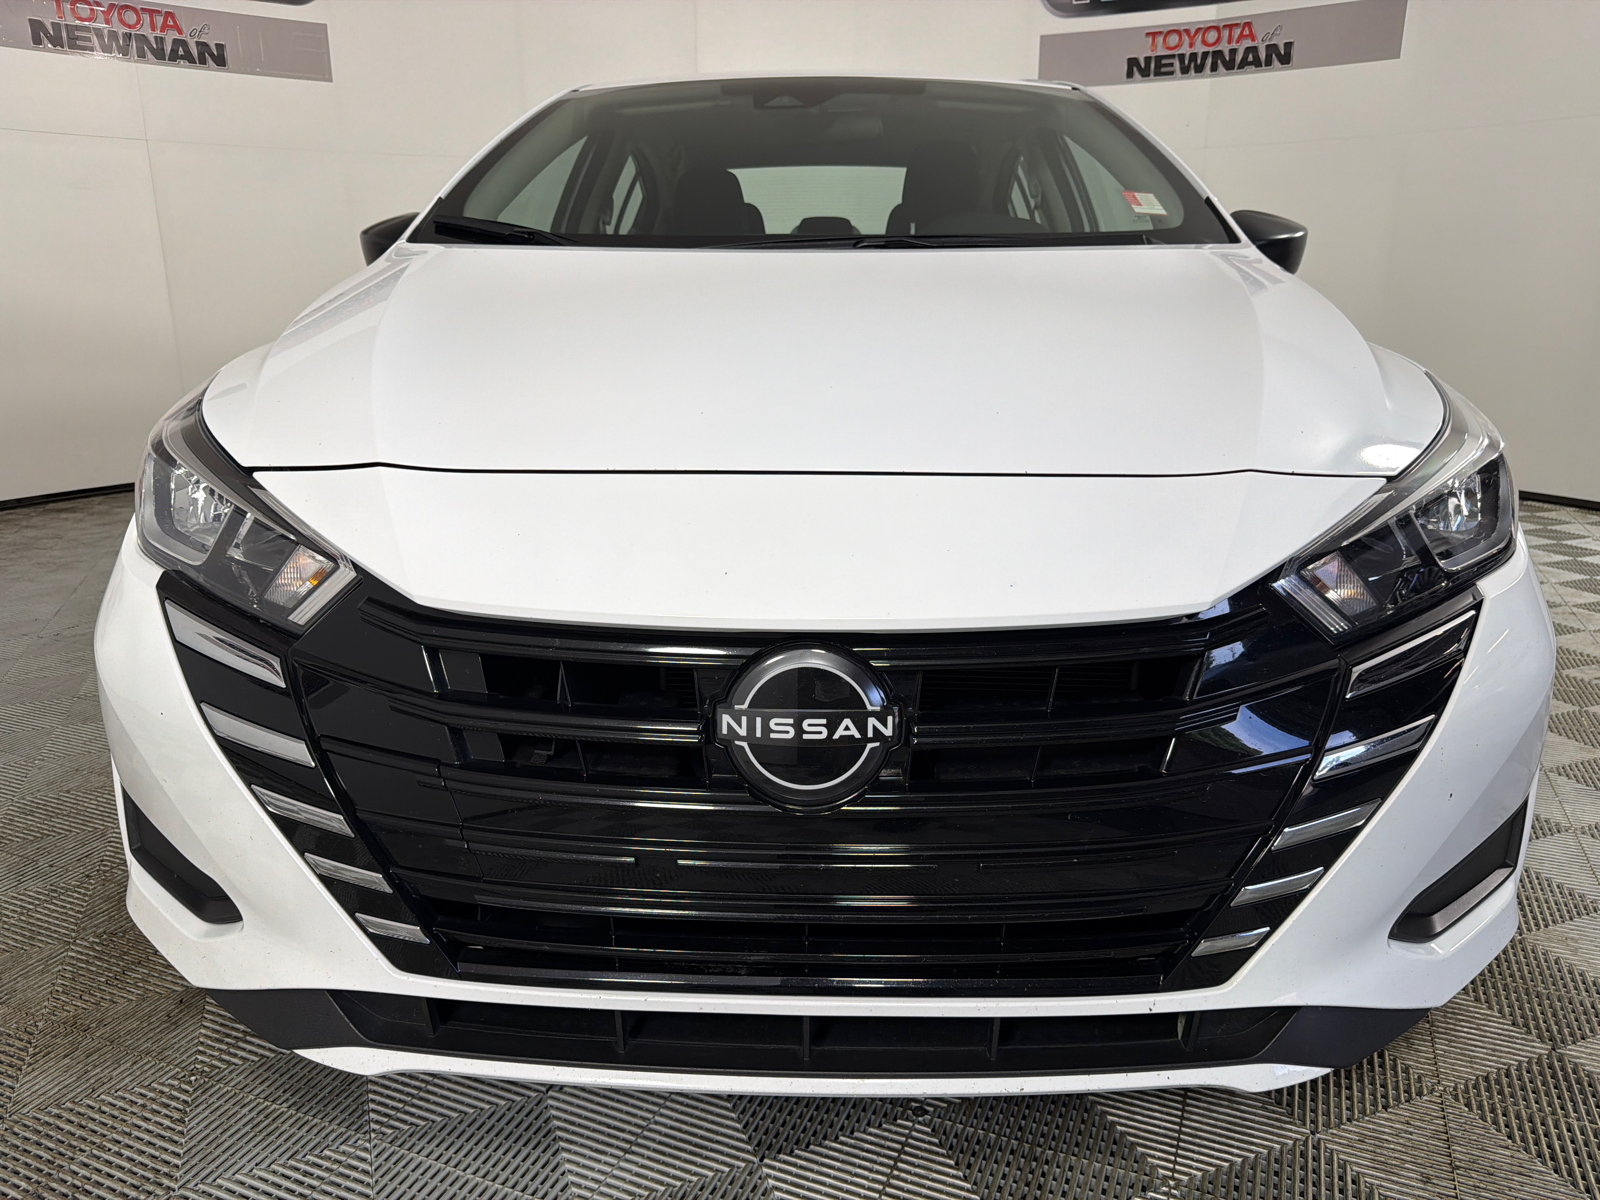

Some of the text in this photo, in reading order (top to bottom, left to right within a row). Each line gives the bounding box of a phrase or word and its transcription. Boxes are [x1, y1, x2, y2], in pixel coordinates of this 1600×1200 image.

[54, 0, 211, 39] TOYOTA of
[1145, 21, 1283, 53] TOYOTA of
[27, 17, 228, 68] NEWNAN
[1126, 41, 1293, 79] NEWNAN
[722, 713, 893, 740] NISSAN
